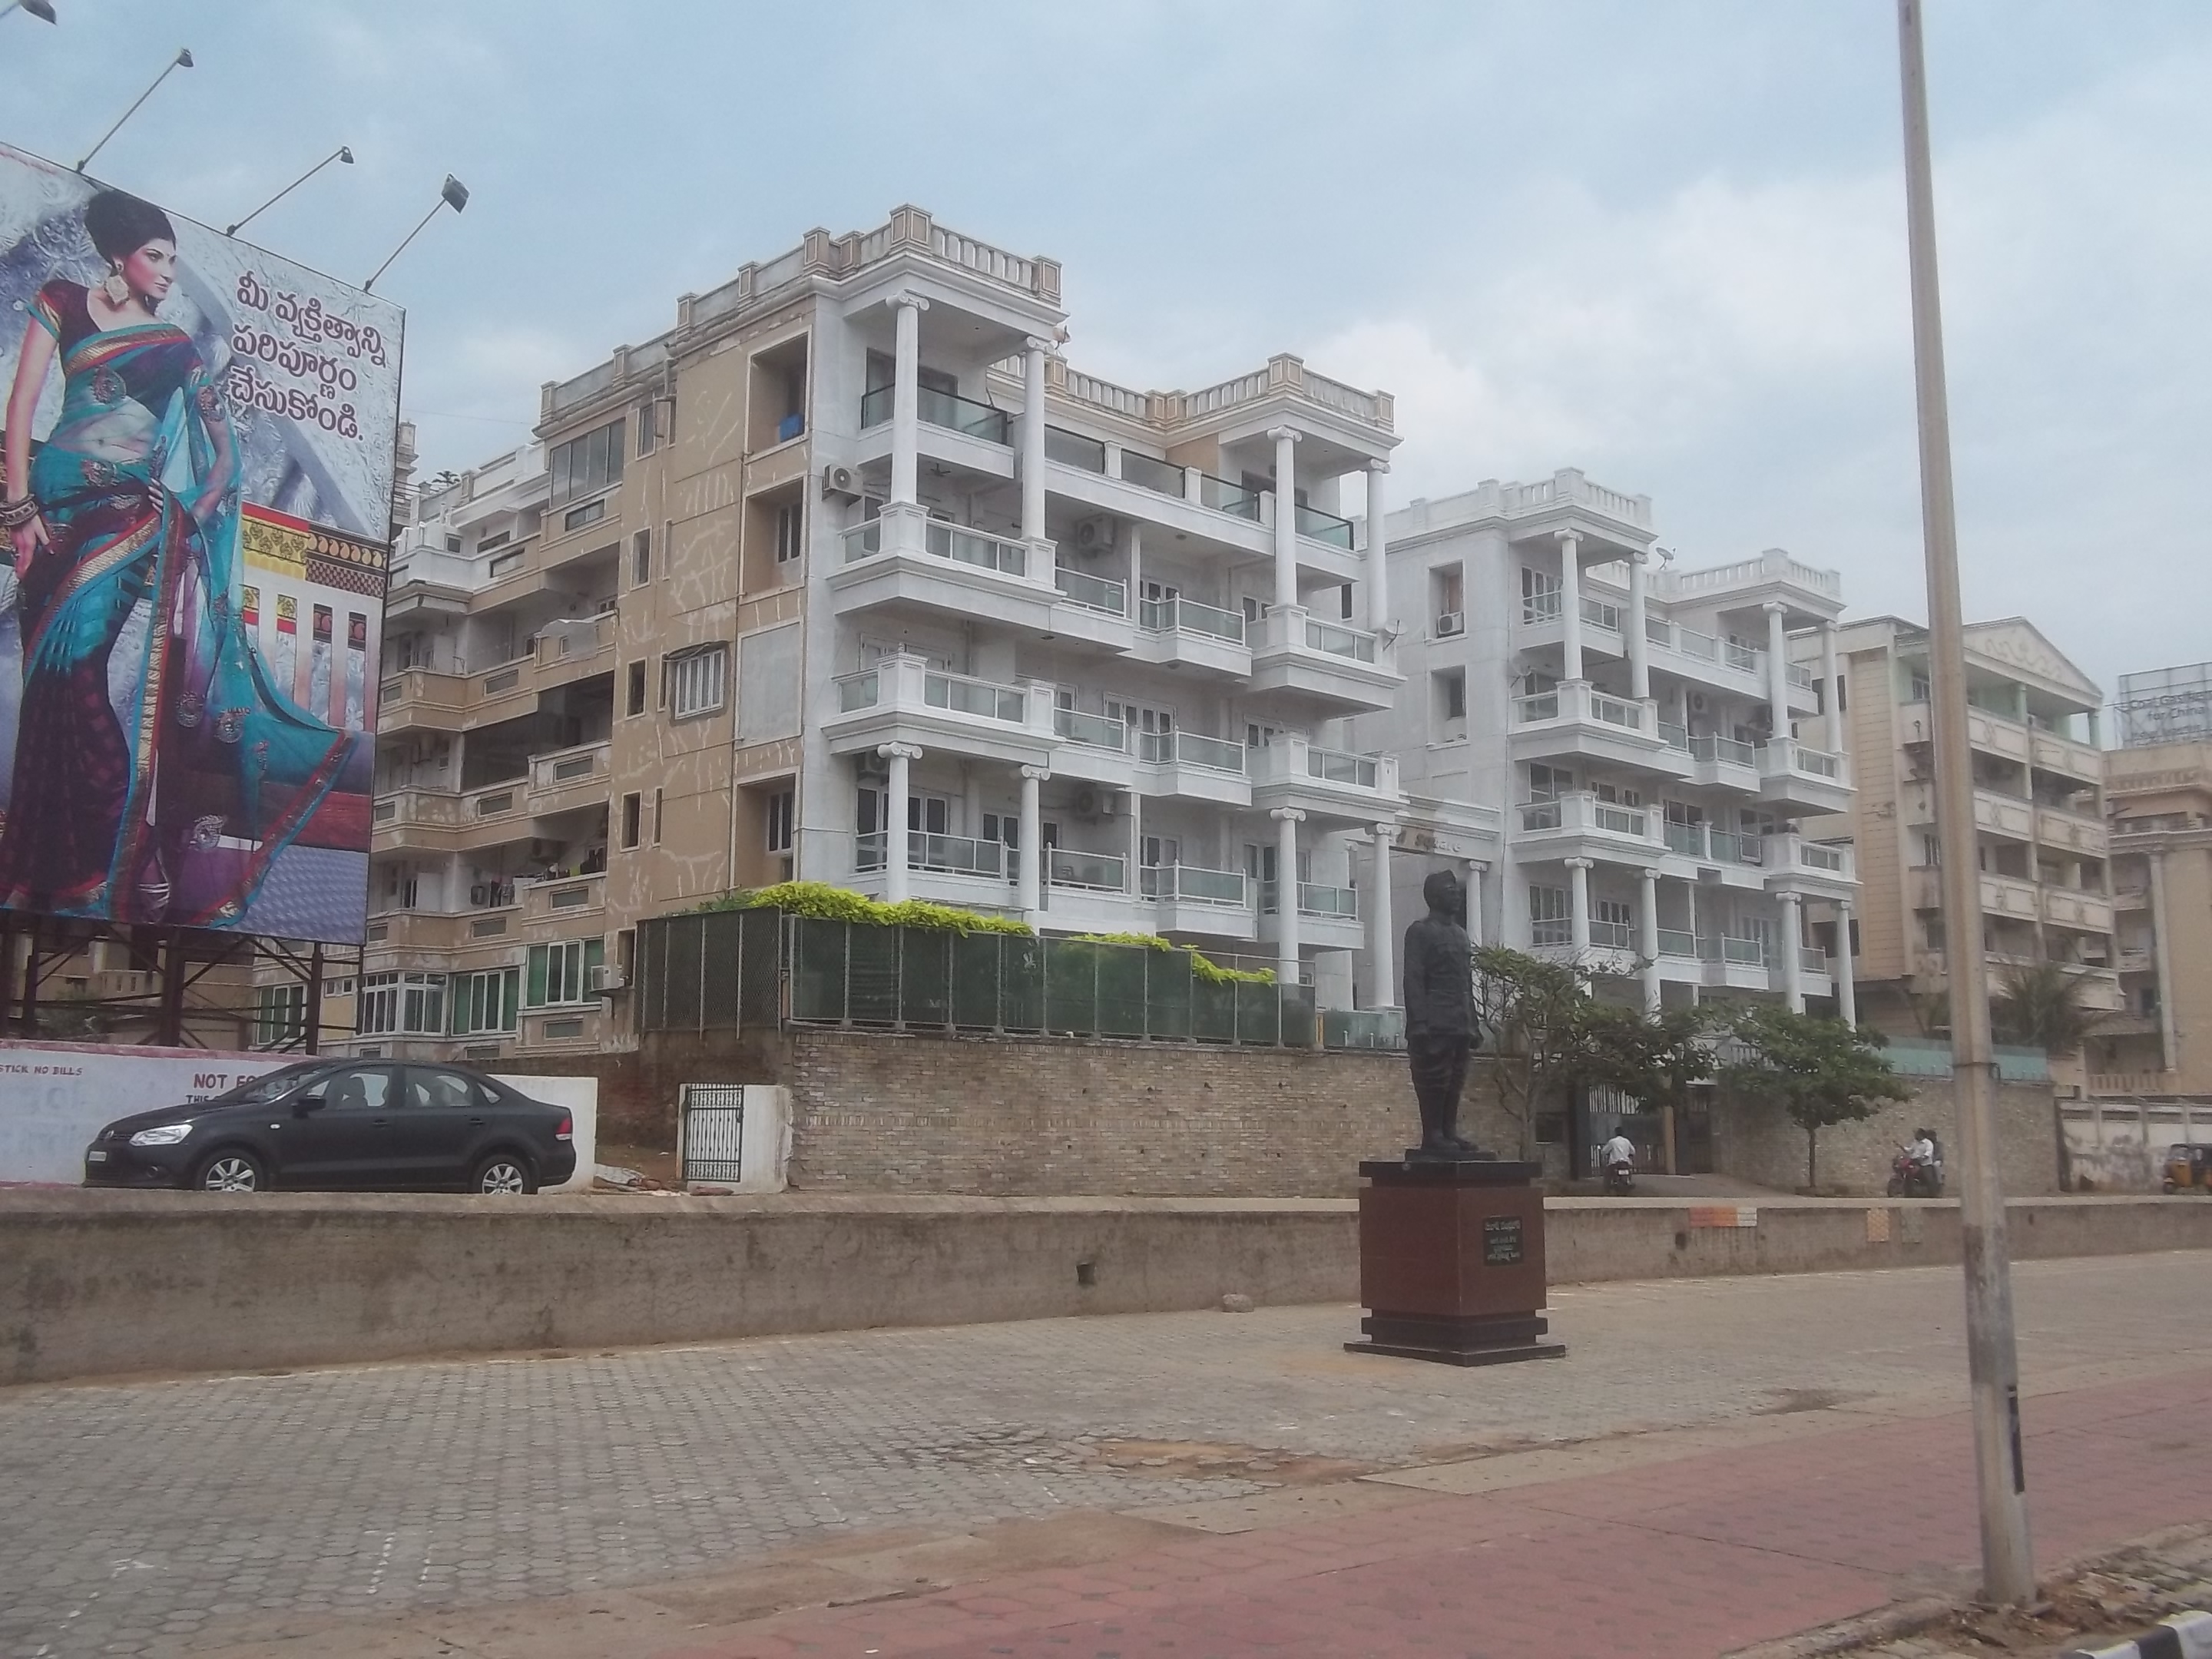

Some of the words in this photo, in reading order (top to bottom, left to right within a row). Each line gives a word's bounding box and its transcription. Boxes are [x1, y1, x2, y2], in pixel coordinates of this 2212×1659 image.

[237, 270, 269, 311] మీ
[275, 291, 388, 369] వ్యక్తిత్వాన్ని
[232, 323, 358, 400] పరిపూర్ణం
[34, 1065, 49, 1075] NO
[52, 1066, 83, 1076] BILLS
[194, 1073, 228, 1089] NOT
